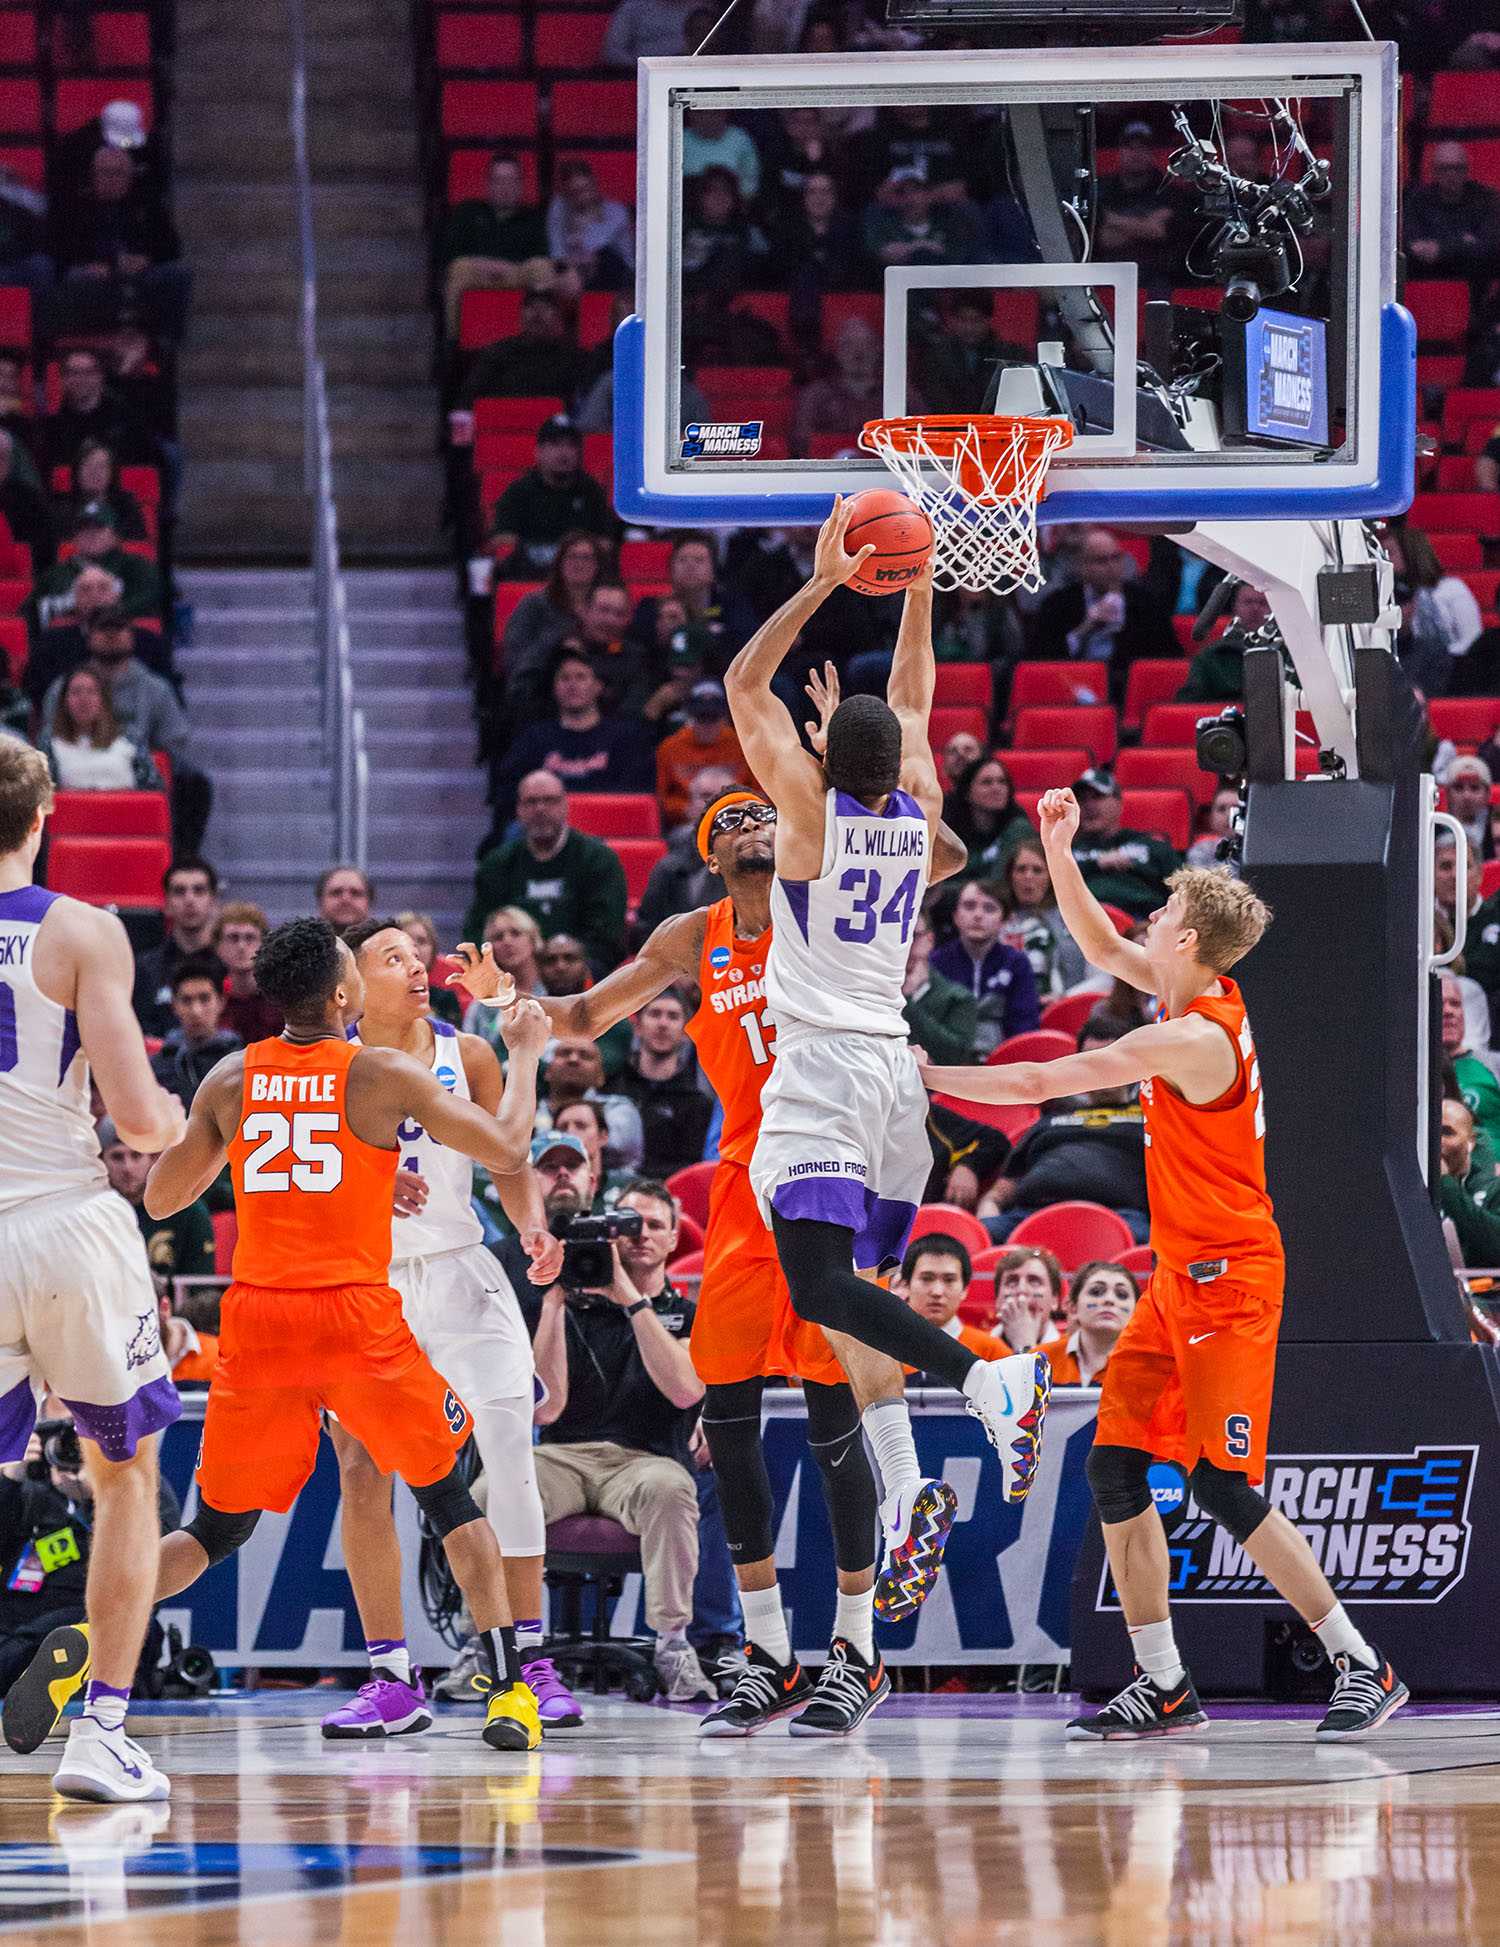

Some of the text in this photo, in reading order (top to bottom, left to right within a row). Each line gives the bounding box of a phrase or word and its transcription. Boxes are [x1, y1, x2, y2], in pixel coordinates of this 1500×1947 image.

[699, 426, 741, 438] MARCH
[703, 438, 759, 451] MADNESS
[845, 828, 924, 857] K. WILLIAMS
[834, 868, 920, 944] 34
[251, 1073, 337, 1102] BATTLE
[242, 1111, 343, 1193] 25
[788, 1161, 840, 1177] HORNED
[1225, 1413, 1252, 1458] S
[1150, 1488, 1183, 1502] CAA
[1207, 1524, 1462, 1577] MDNESS
